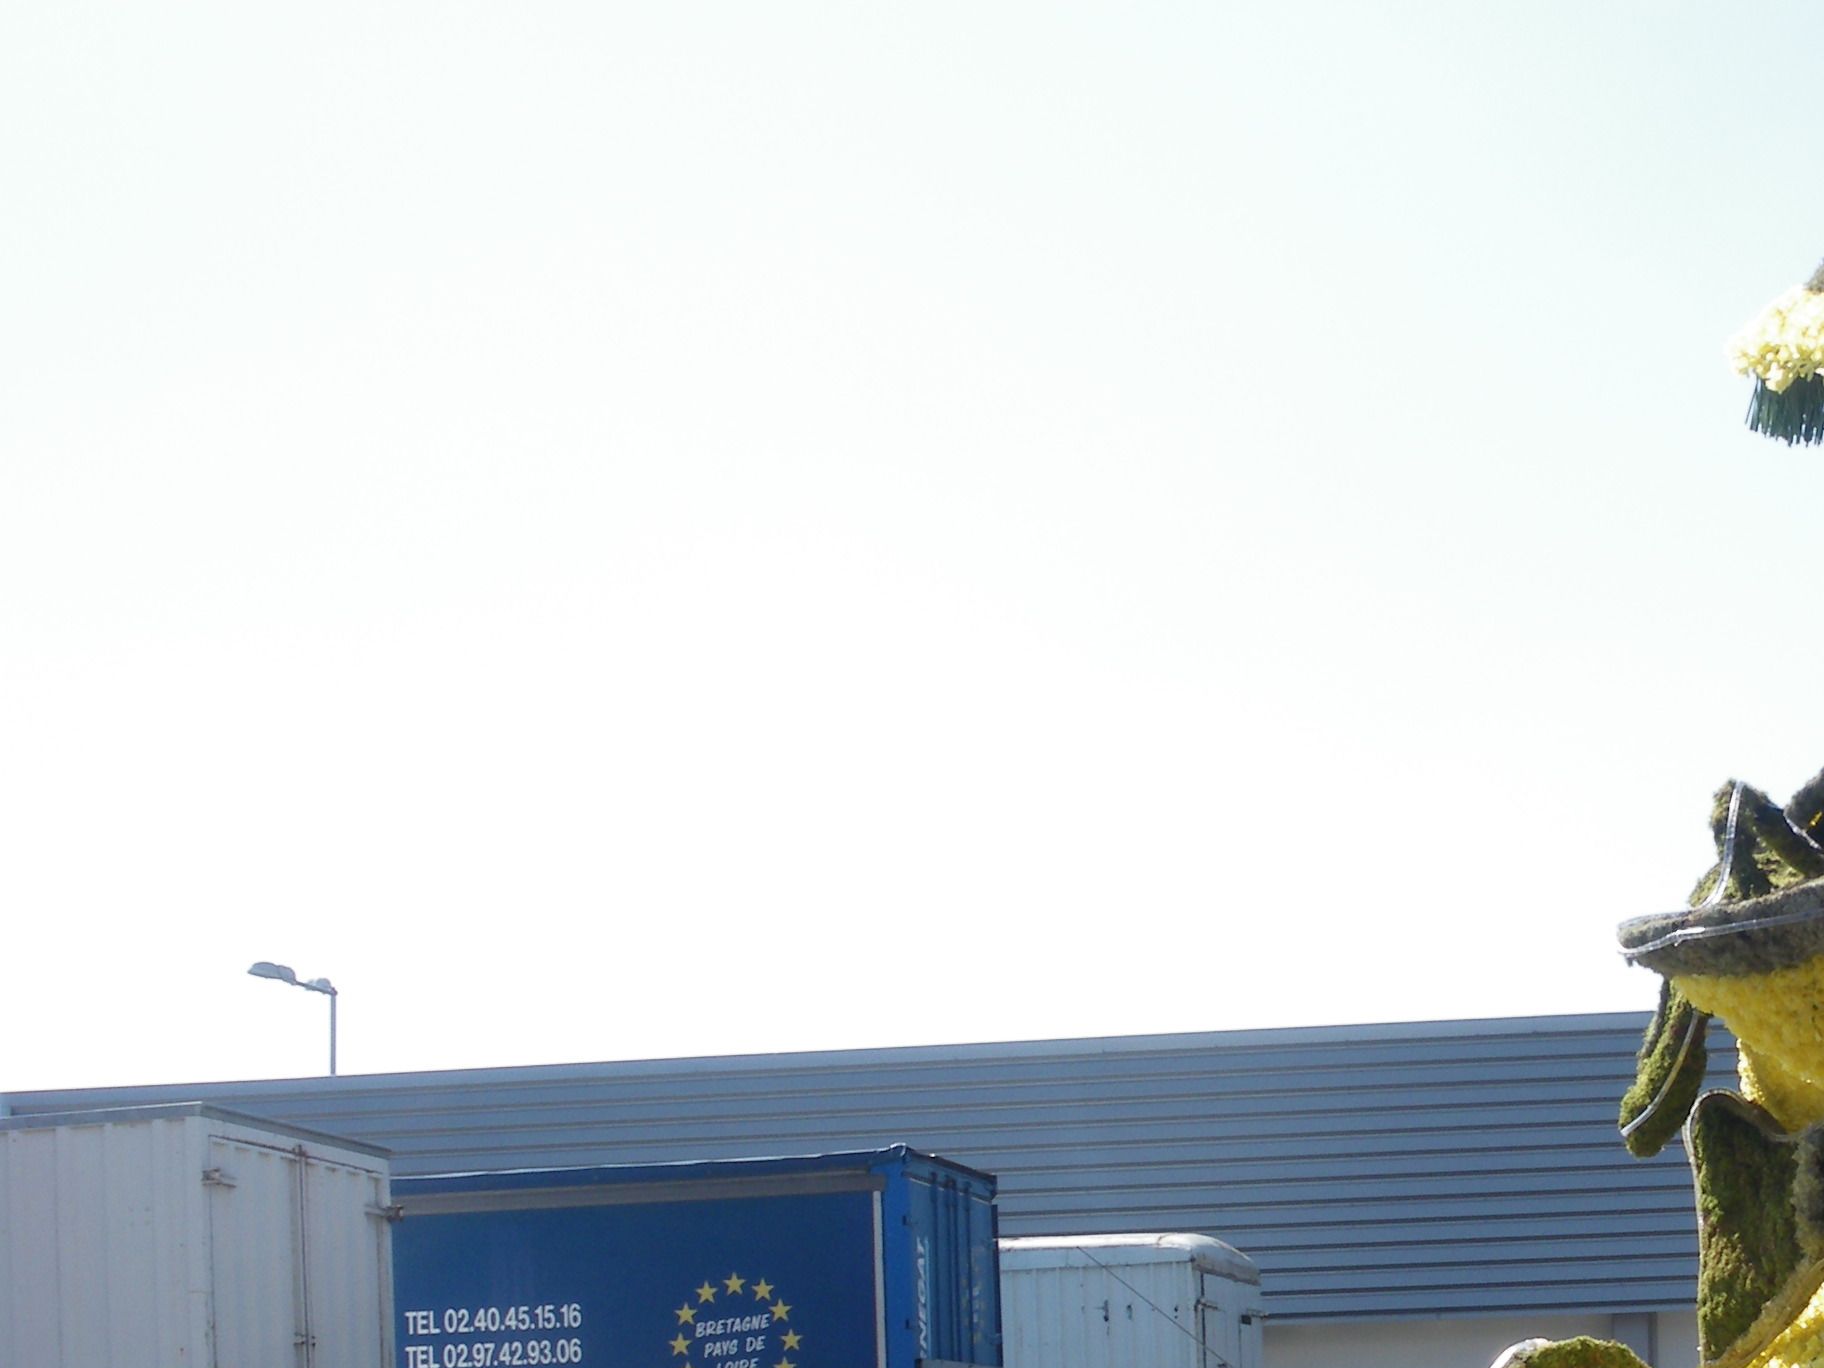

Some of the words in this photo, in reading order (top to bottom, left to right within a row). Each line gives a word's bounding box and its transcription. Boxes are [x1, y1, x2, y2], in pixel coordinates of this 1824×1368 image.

[404, 1311, 441, 1335] TEL
[444, 1303, 582, 1334] 02.40.45.15.16
[695, 1313, 770, 1338] BRETAGNE
[443, 1338, 583, 1368] 02.97.42.93.06
[704, 1339, 739, 1358] PAYS
[746, 1336, 766, 1352] DE
